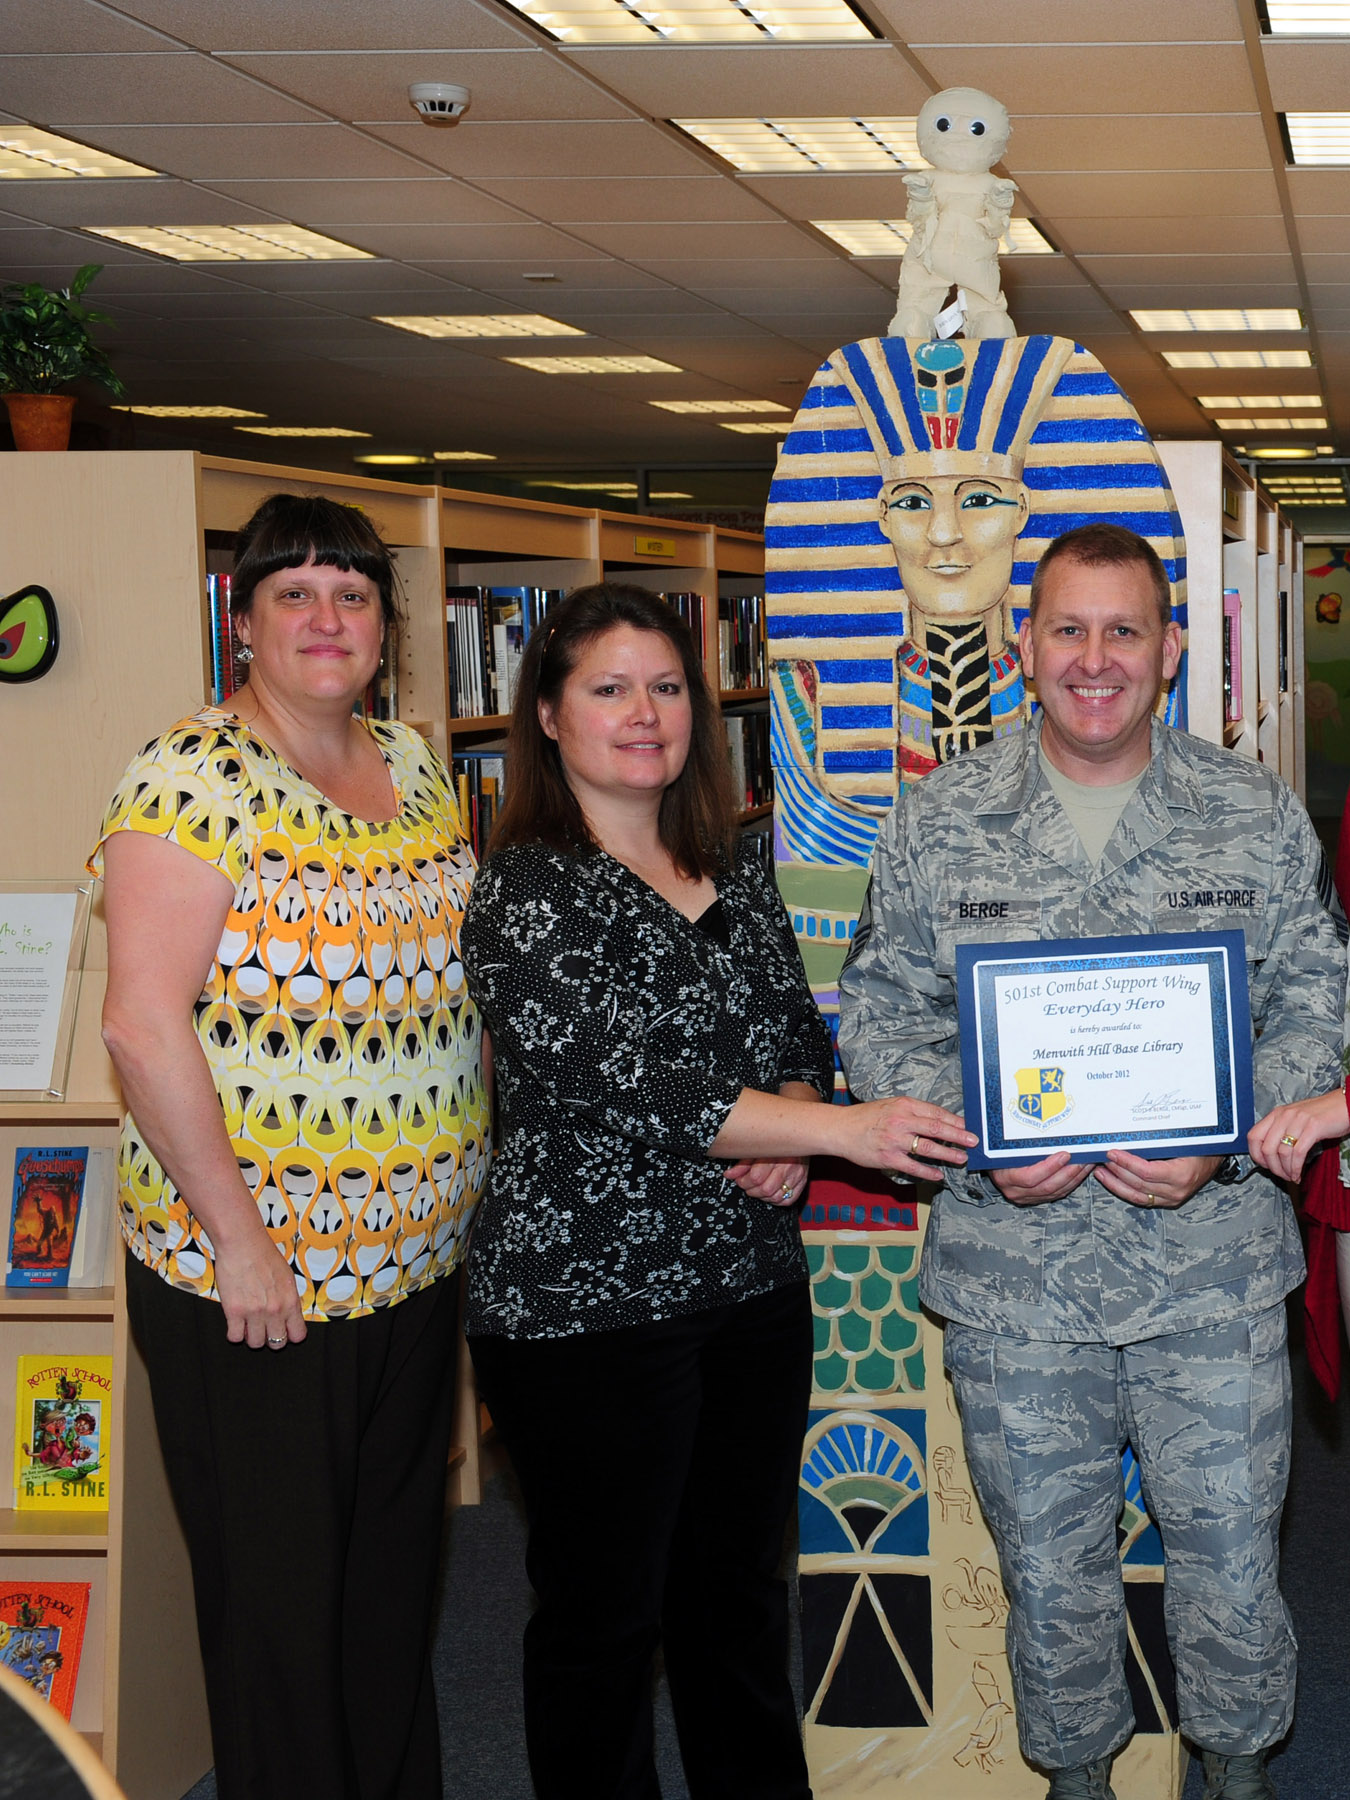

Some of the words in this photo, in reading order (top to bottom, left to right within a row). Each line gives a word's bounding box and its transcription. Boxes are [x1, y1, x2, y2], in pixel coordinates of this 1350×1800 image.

[1168, 893, 1192, 908] U.S.
[1194, 891, 1216, 907] AIR
[1217, 889, 1256, 907] FORCE
[959, 902, 1009, 918] BERGE
[24, 924, 32, 936] is
[1004, 985, 1042, 1005] 501st
[1046, 976, 1099, 997] Combat
[1102, 975, 1157, 993] Support
[1162, 975, 1201, 996] Wing
[1043, 999, 1121, 1017] Everyday
[1124, 997, 1165, 1012] Hero
[1070, 1026, 1076, 1034] is
[1078, 1025, 1100, 1035] hereby
[1101, 1023, 1132, 1032] awarded
[1133, 1023, 1142, 1031] to:
[1032, 1046, 1085, 1060] Menwith
[1087, 1043, 1111, 1057] Hill
[1113, 1043, 1139, 1055] Base
[1142, 1040, 1184, 1054] Library
[1086, 1070, 1113, 1080] October
[1115, 1069, 1130, 1079] 2012
[27, 1367, 69, 1389] ROTTEN
[72, 1368, 112, 1392] SCHOOL
[26, 1481, 56, 1496] R.L.
[62, 1481, 105, 1497] STINE
[35, 1594, 74, 1619] SCHOOL
